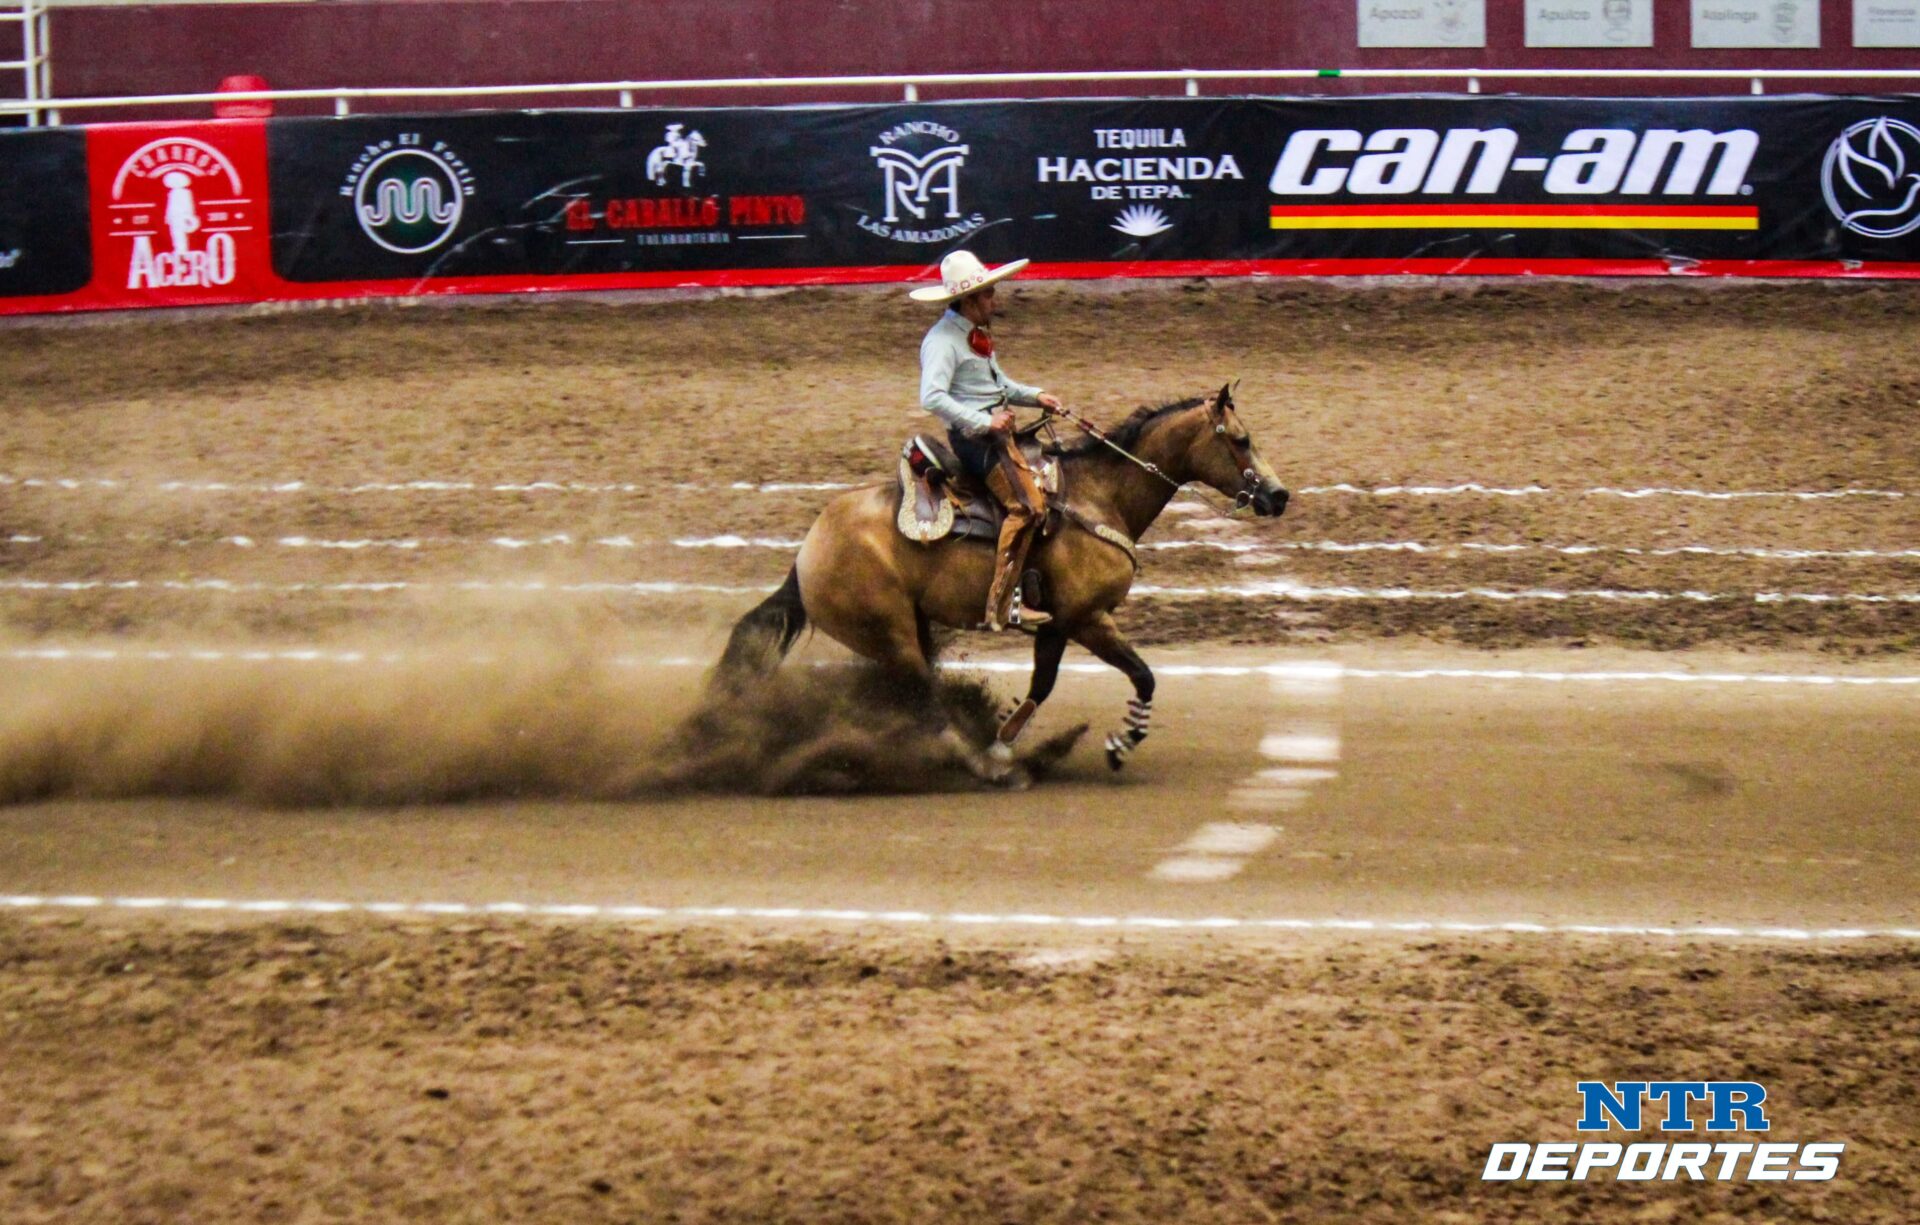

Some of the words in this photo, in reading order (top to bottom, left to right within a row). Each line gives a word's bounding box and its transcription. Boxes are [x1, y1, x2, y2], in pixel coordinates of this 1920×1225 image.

[398, 133, 420, 145] El
[878, 121, 960, 145] RANCHO
[1093, 128, 1186, 149] TEQUILA
[1037, 154, 1244, 182] HACIENDA
[1091, 186, 1122, 200] DE
[566, 200, 595, 230] EL
[607, 196, 720, 228] CABALLO
[729, 195, 806, 225] PINTO
[856, 215, 891, 237] LAS
[890, 213, 985, 243] AMAZONAS
